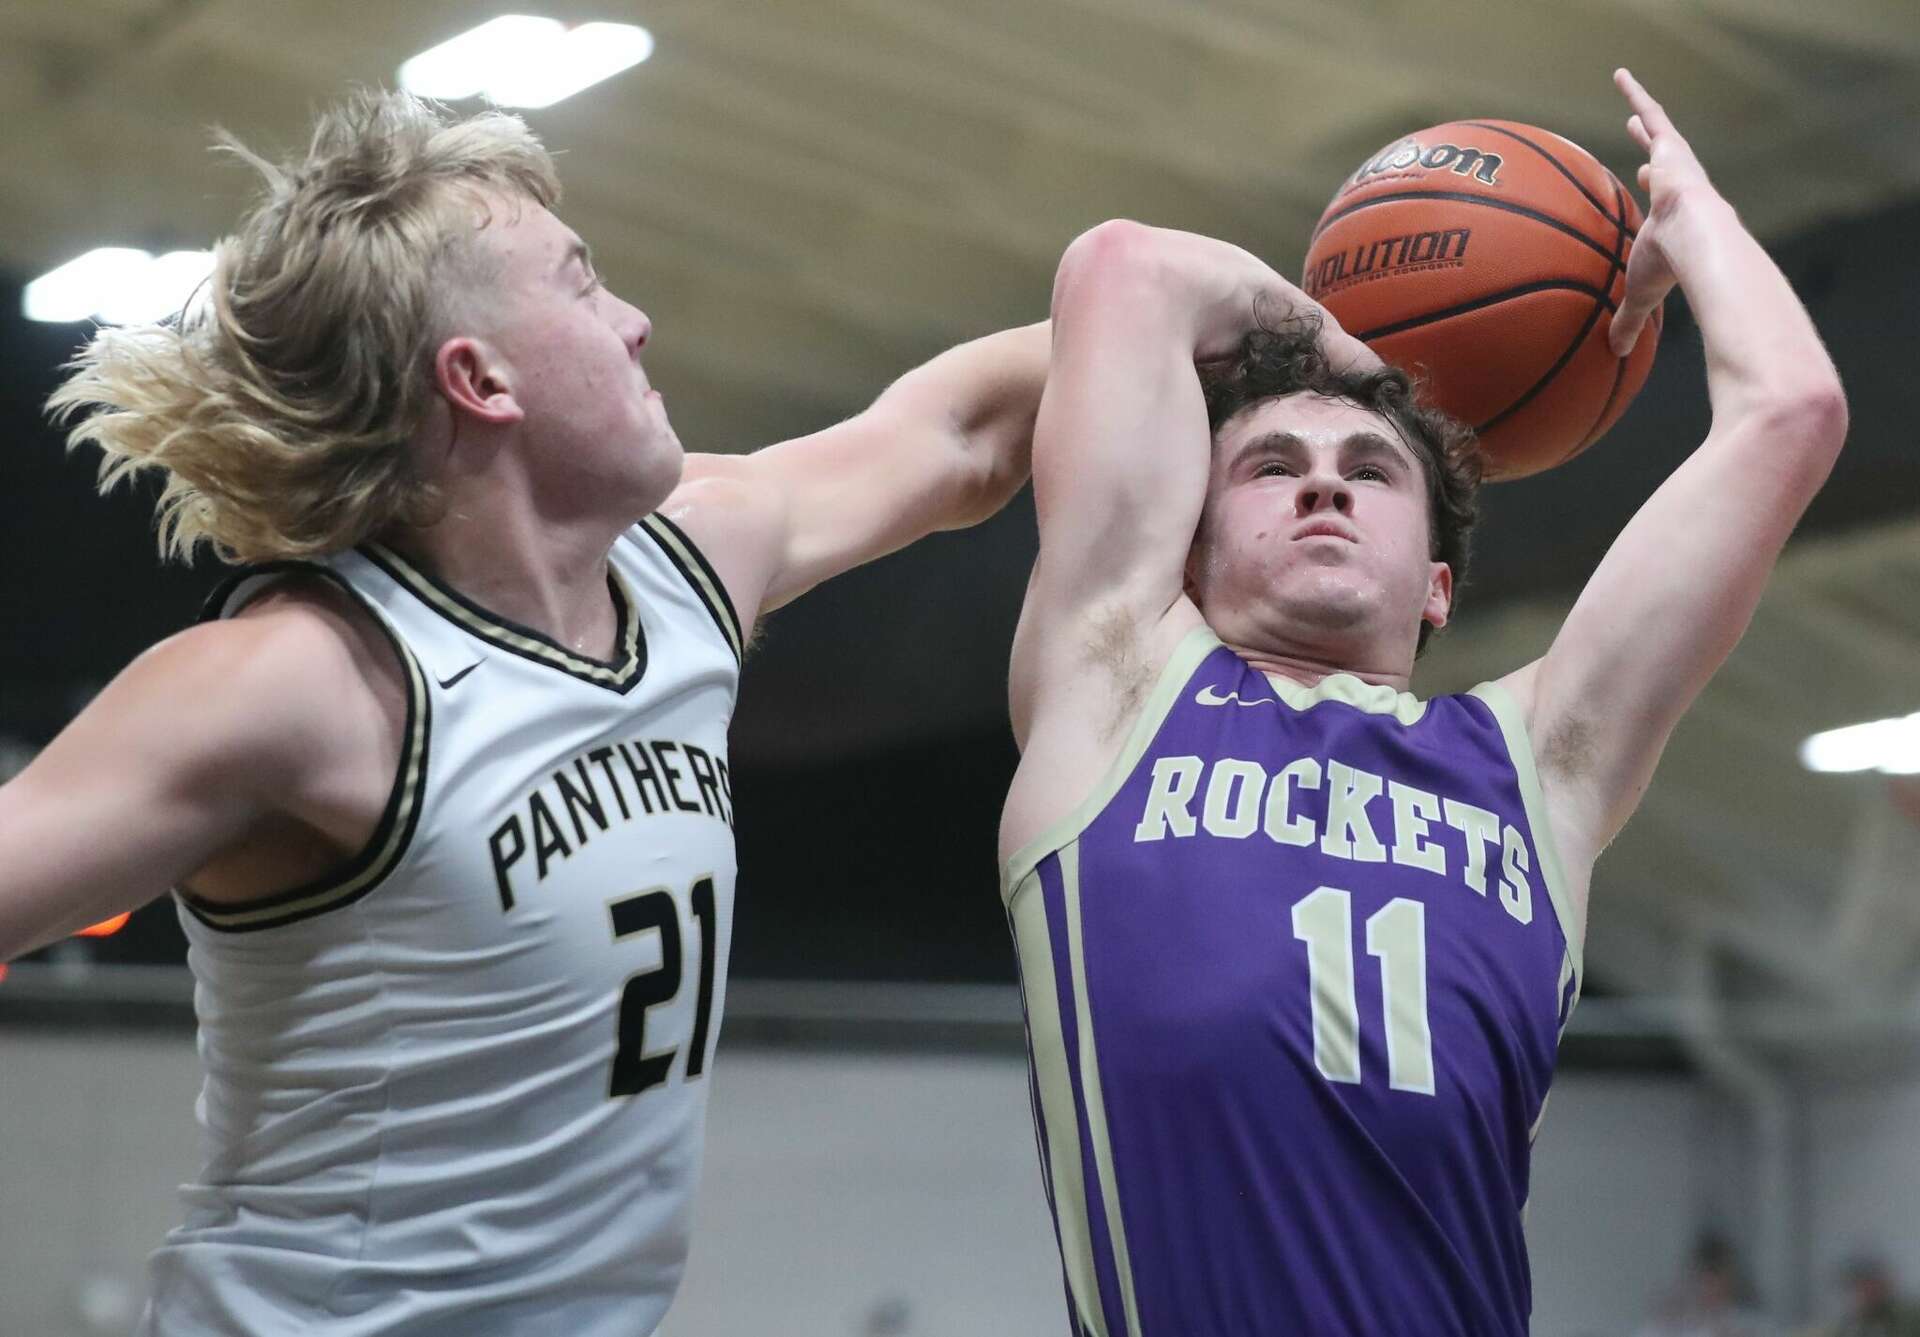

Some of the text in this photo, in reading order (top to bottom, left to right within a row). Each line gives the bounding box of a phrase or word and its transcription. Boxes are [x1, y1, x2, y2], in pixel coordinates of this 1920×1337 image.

[1304, 228, 1472, 297] VOLUTION
[1134, 755, 1533, 926] ROCKETS
[607, 873, 719, 1101] 21
[1291, 885, 1436, 1097] 11
